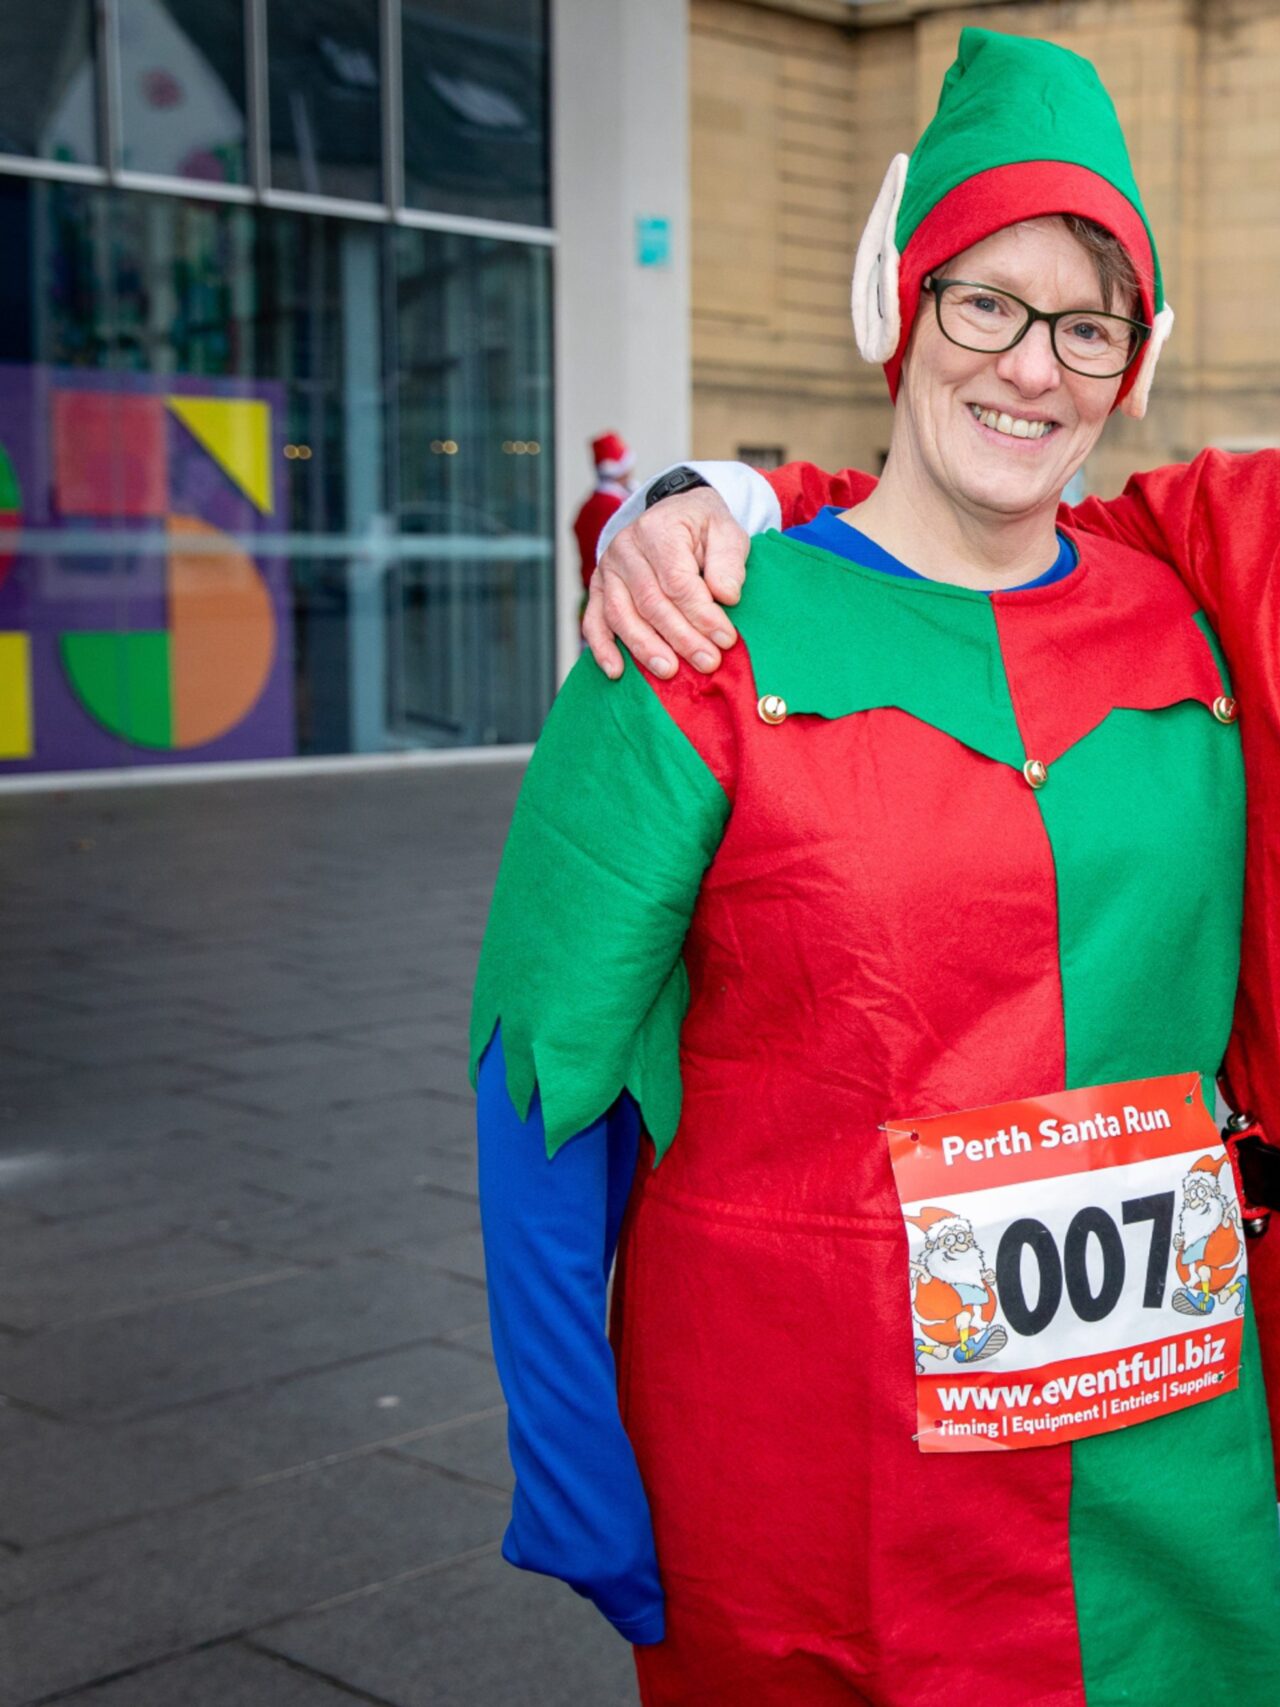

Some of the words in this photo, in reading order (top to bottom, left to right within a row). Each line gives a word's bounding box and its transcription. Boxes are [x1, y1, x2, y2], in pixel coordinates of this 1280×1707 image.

[942, 1125, 1032, 1166] Perth
[1038, 1113, 1121, 1148] Santa
[1123, 1105, 1171, 1135] Run
[996, 1190, 1175, 1336] 007
[936, 1334, 1226, 1412] www.eventfull.biz
[1012, 1404, 1100, 1433] Equipment
[1110, 1390, 1160, 1415] Entries
